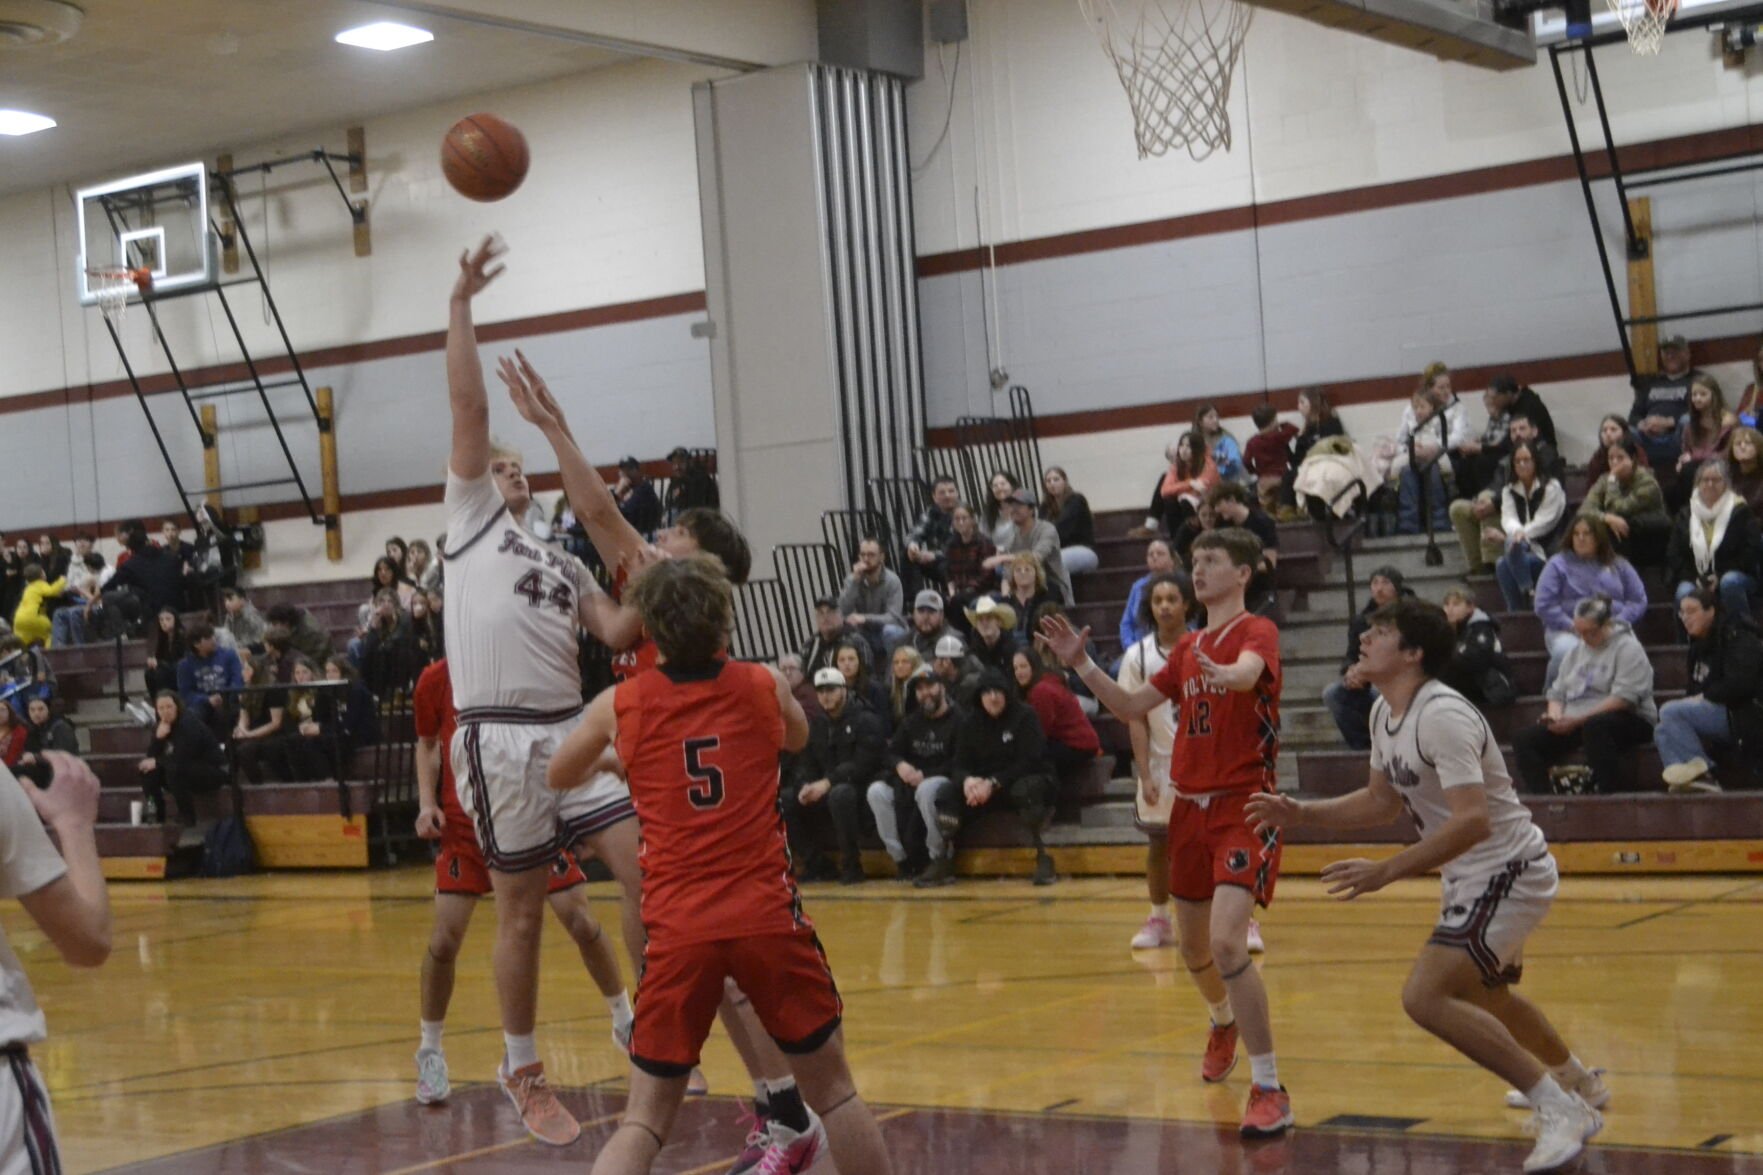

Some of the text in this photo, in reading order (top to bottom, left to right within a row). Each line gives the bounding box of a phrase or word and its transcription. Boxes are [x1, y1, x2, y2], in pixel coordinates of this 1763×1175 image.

[514, 568, 574, 615] 44
[1187, 699, 1213, 737] 12
[683, 734, 726, 811] 5
